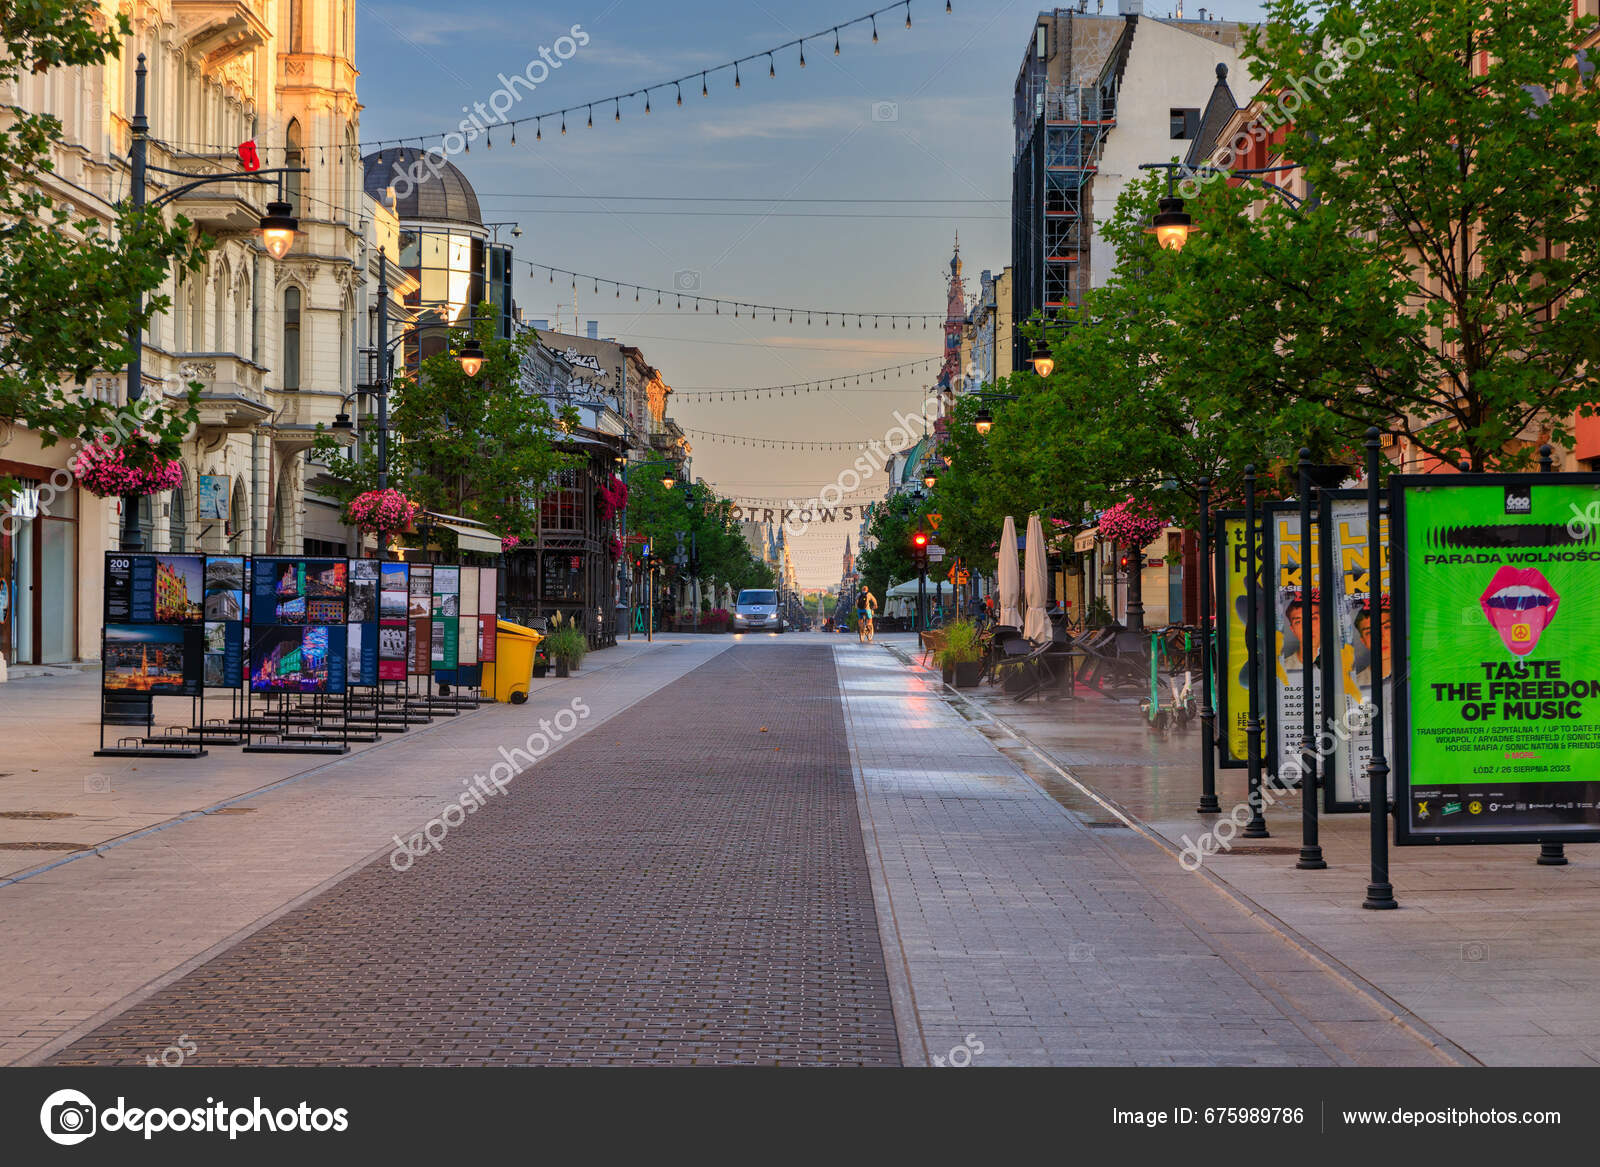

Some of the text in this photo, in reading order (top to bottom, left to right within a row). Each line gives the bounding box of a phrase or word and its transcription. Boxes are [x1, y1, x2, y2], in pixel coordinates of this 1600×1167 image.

[110, 559, 130, 568] 200
[1424, 554, 1502, 565] PARADA
[1481, 660, 1561, 680] TASTE
[1431, 682, 1482, 701] THE
[1461, 700, 1583, 721] OF MUSIC
[1416, 727, 1484, 735] TRANSFORMATOR
[1491, 726, 1533, 734] SZPITALNA
[1572, 724, 1592, 732] DATE
[1478, 734, 1514, 742] ARYADNE
[1515, 733, 1560, 742] STERNFELD
[1567, 733, 1591, 741] SONIC
[1445, 744, 1472, 752] HOUSE
[1473, 743, 1498, 752] MAFIA
[1505, 743, 1529, 751] SONIC
[1530, 742, 1559, 750] NATION
[1567, 741, 1600, 750] FRIENDS
[1513, 765, 1549, 773] SIERPNIA
[1550, 764, 1571, 773] 2023
